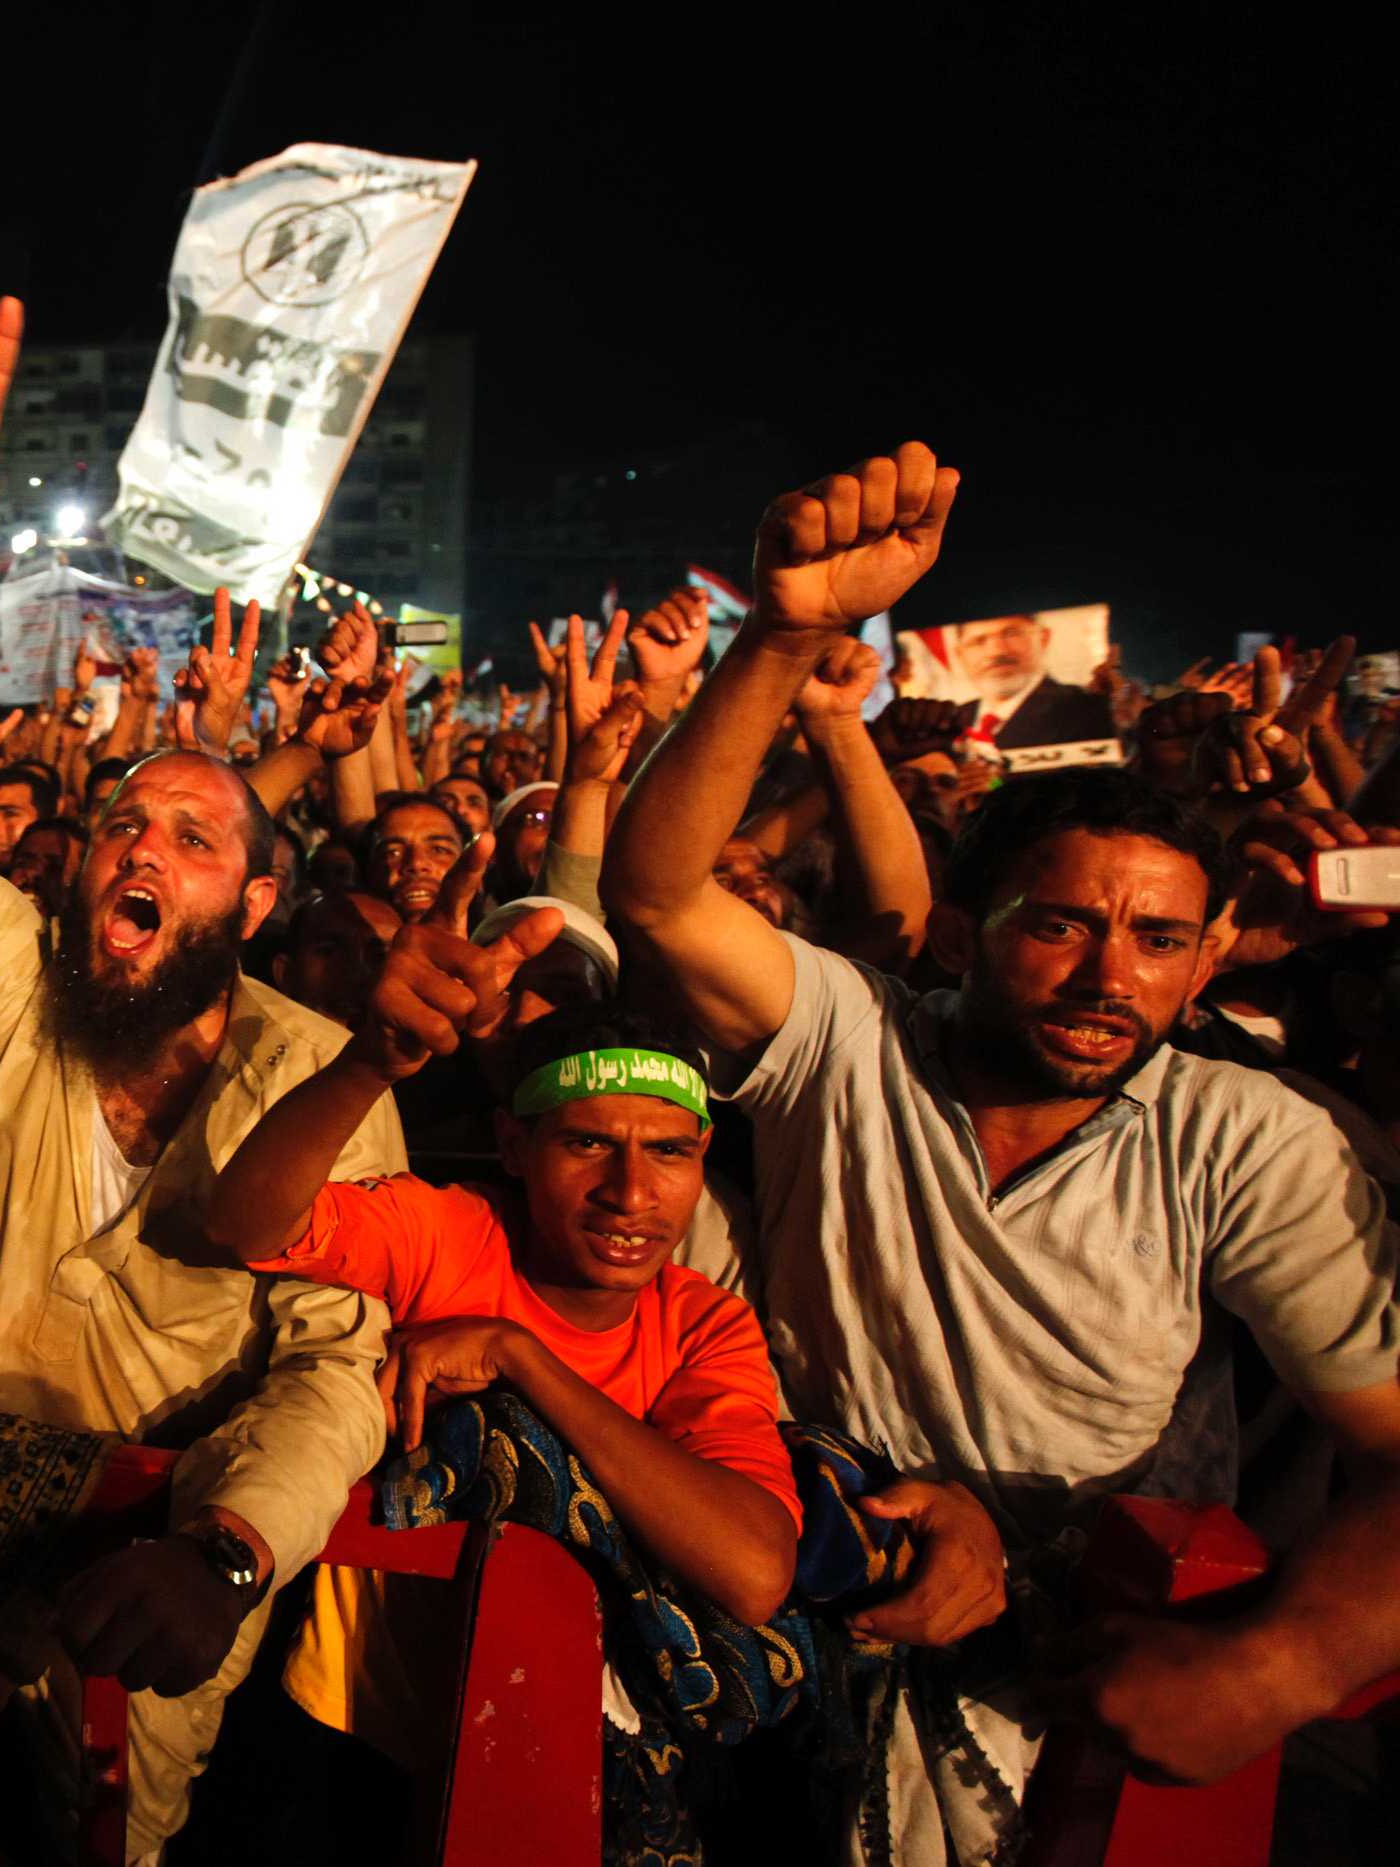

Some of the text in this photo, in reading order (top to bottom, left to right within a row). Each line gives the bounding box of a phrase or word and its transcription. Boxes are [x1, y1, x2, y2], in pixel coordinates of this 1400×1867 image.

[558, 1055, 582, 1088] الله
[585, 1050, 628, 1091] رسول
[630, 1051, 669, 1082] محمد
